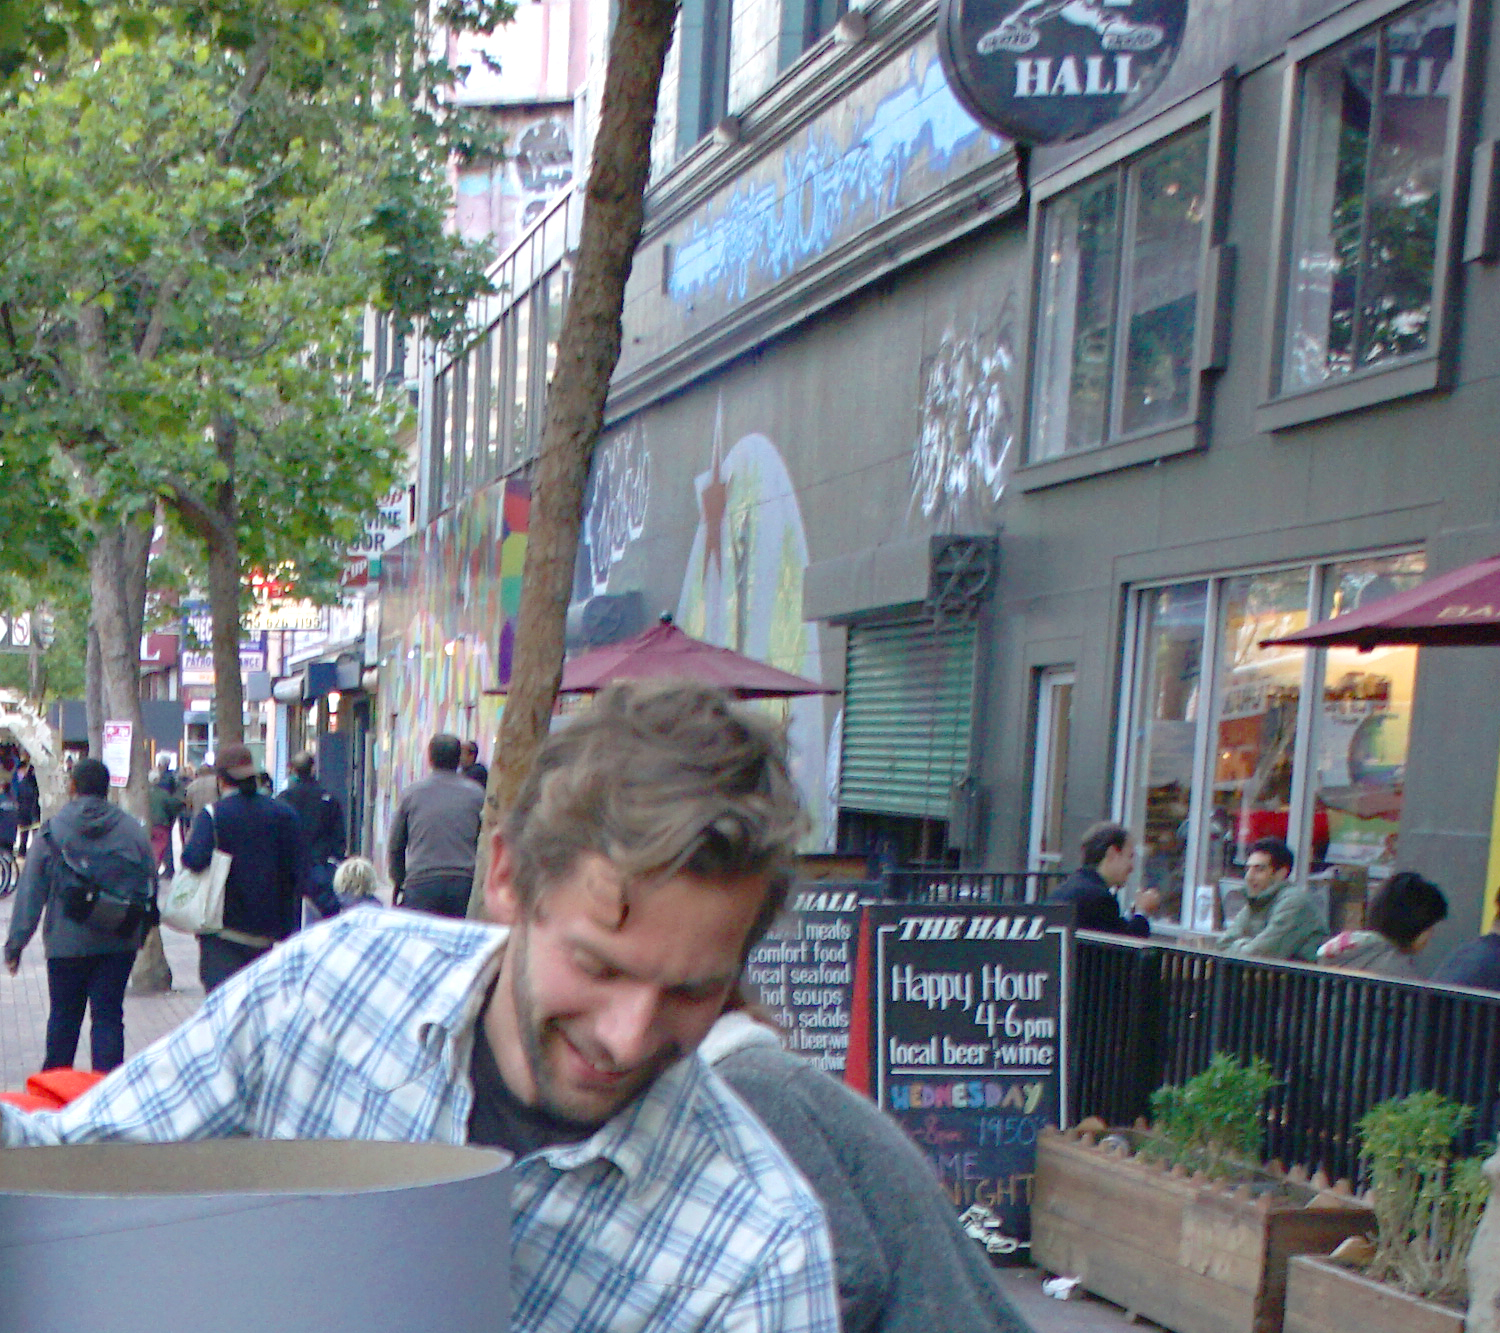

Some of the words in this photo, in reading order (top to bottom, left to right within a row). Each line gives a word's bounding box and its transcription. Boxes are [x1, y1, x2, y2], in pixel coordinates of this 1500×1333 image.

[1013, 55, 1141, 97] HALL
[792, 892, 858, 912] HALL
[806, 917, 851, 941] meals
[899, 916, 966, 940] THE
[963, 916, 1047, 940] HALL
[748, 941, 808, 963] comfort
[814, 941, 849, 963] food
[748, 963, 786, 985] local
[791, 963, 851, 984] seafood
[759, 985, 786, 1006] hot
[792, 988, 843, 1010] soups
[891, 963, 973, 1012] Happy
[982, 963, 1049, 1001] Hour
[798, 1006, 850, 1028] salads
[889, 1035, 938, 1064] local
[942, 1035, 990, 1065] beer
[1001, 1041, 1055, 1065] wine
[890, 1080, 1044, 1115] WEDNESDAY
